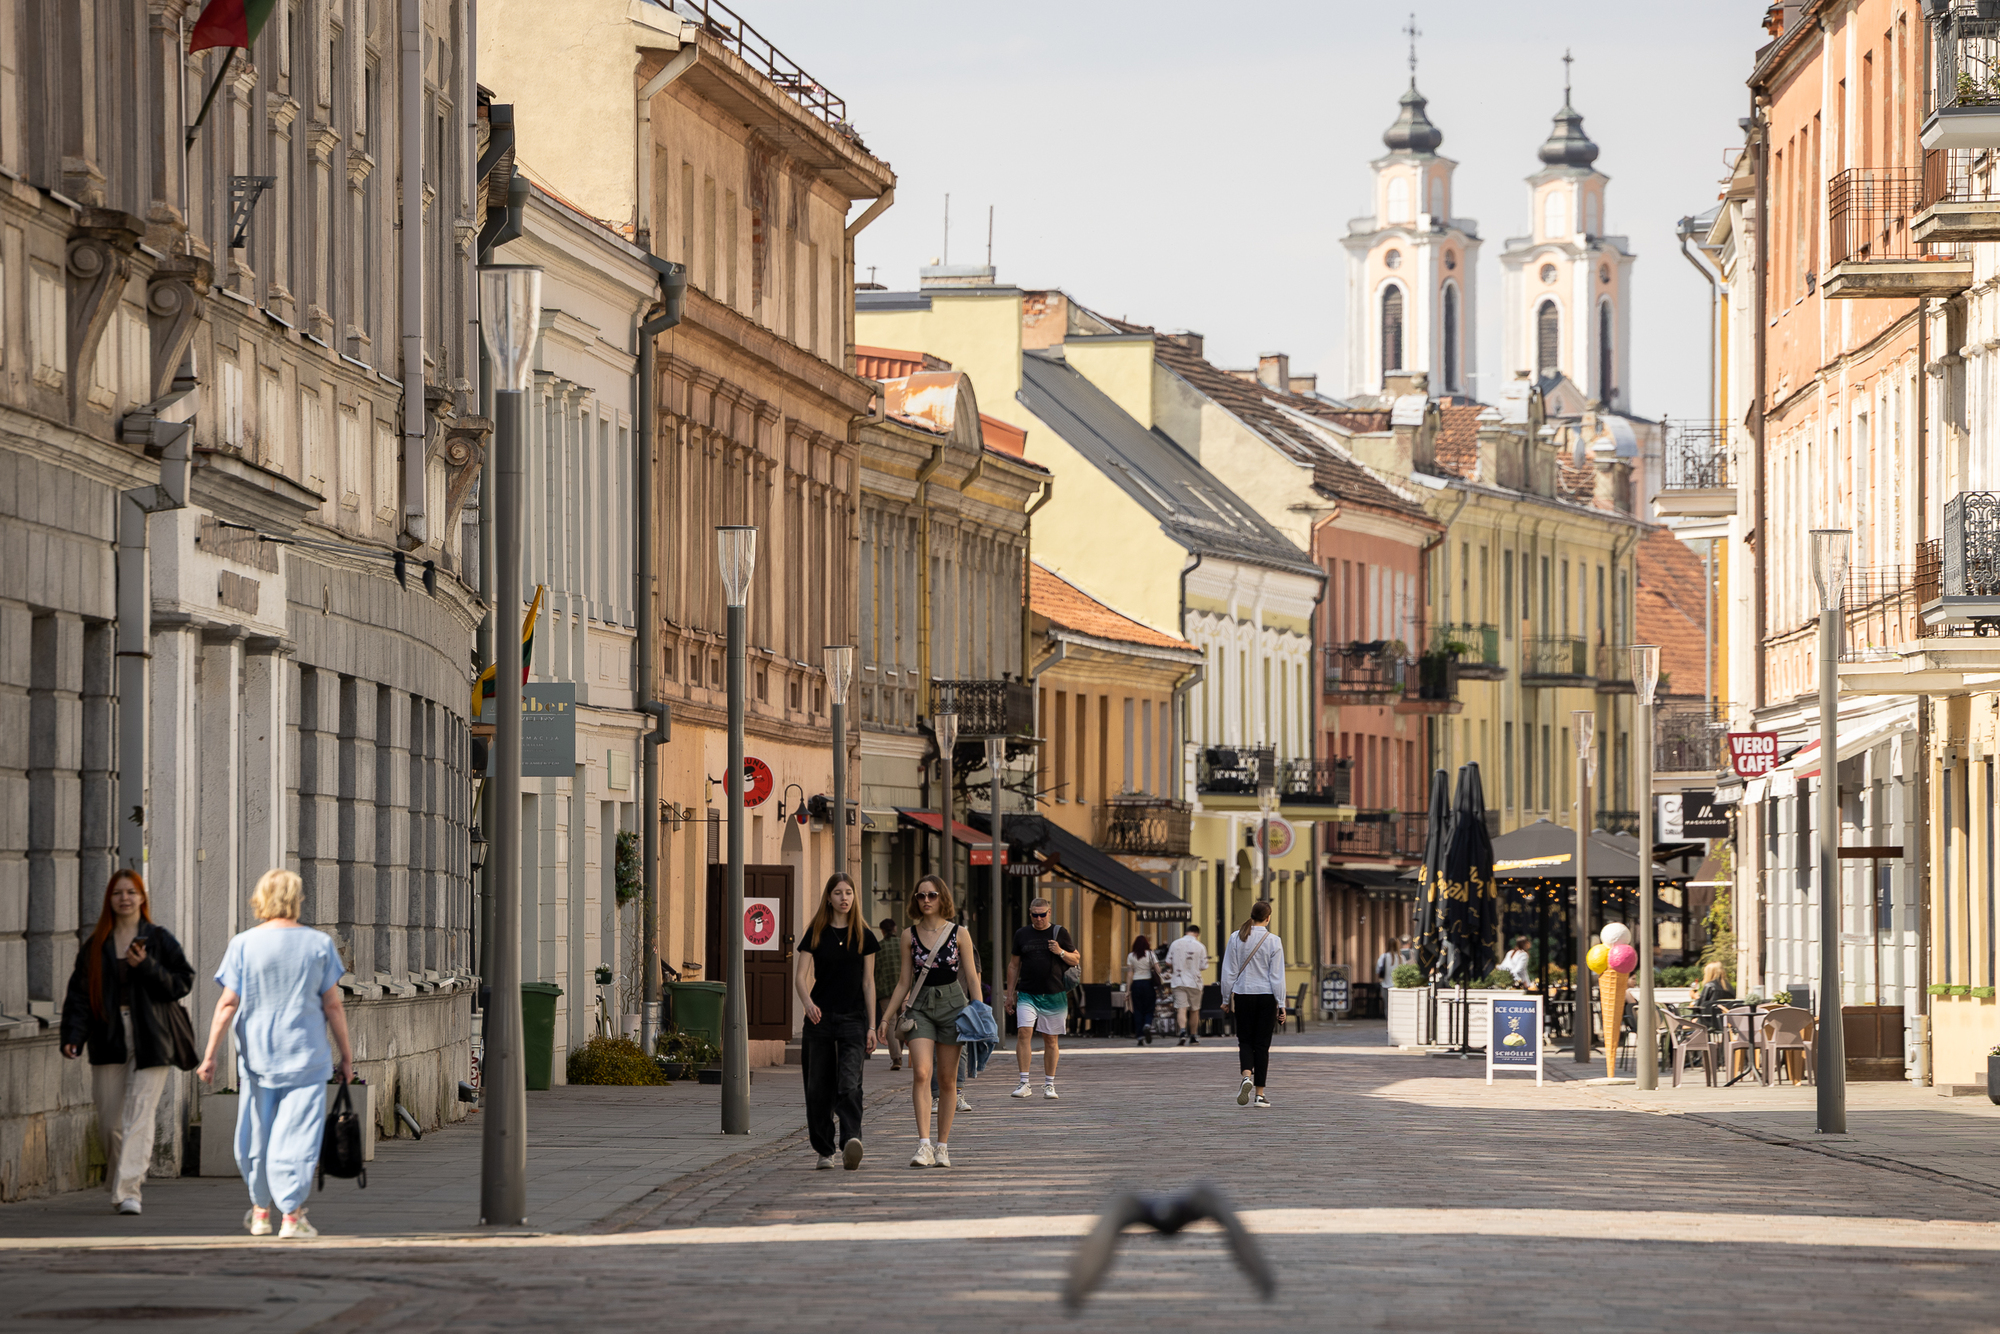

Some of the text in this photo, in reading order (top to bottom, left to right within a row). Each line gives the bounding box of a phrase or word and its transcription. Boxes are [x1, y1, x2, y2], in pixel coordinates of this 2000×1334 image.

[1732, 736, 1774, 754] VERO
[1738, 755, 1774, 773] CAFE
[1009, 864, 1041, 875] AVILYS
